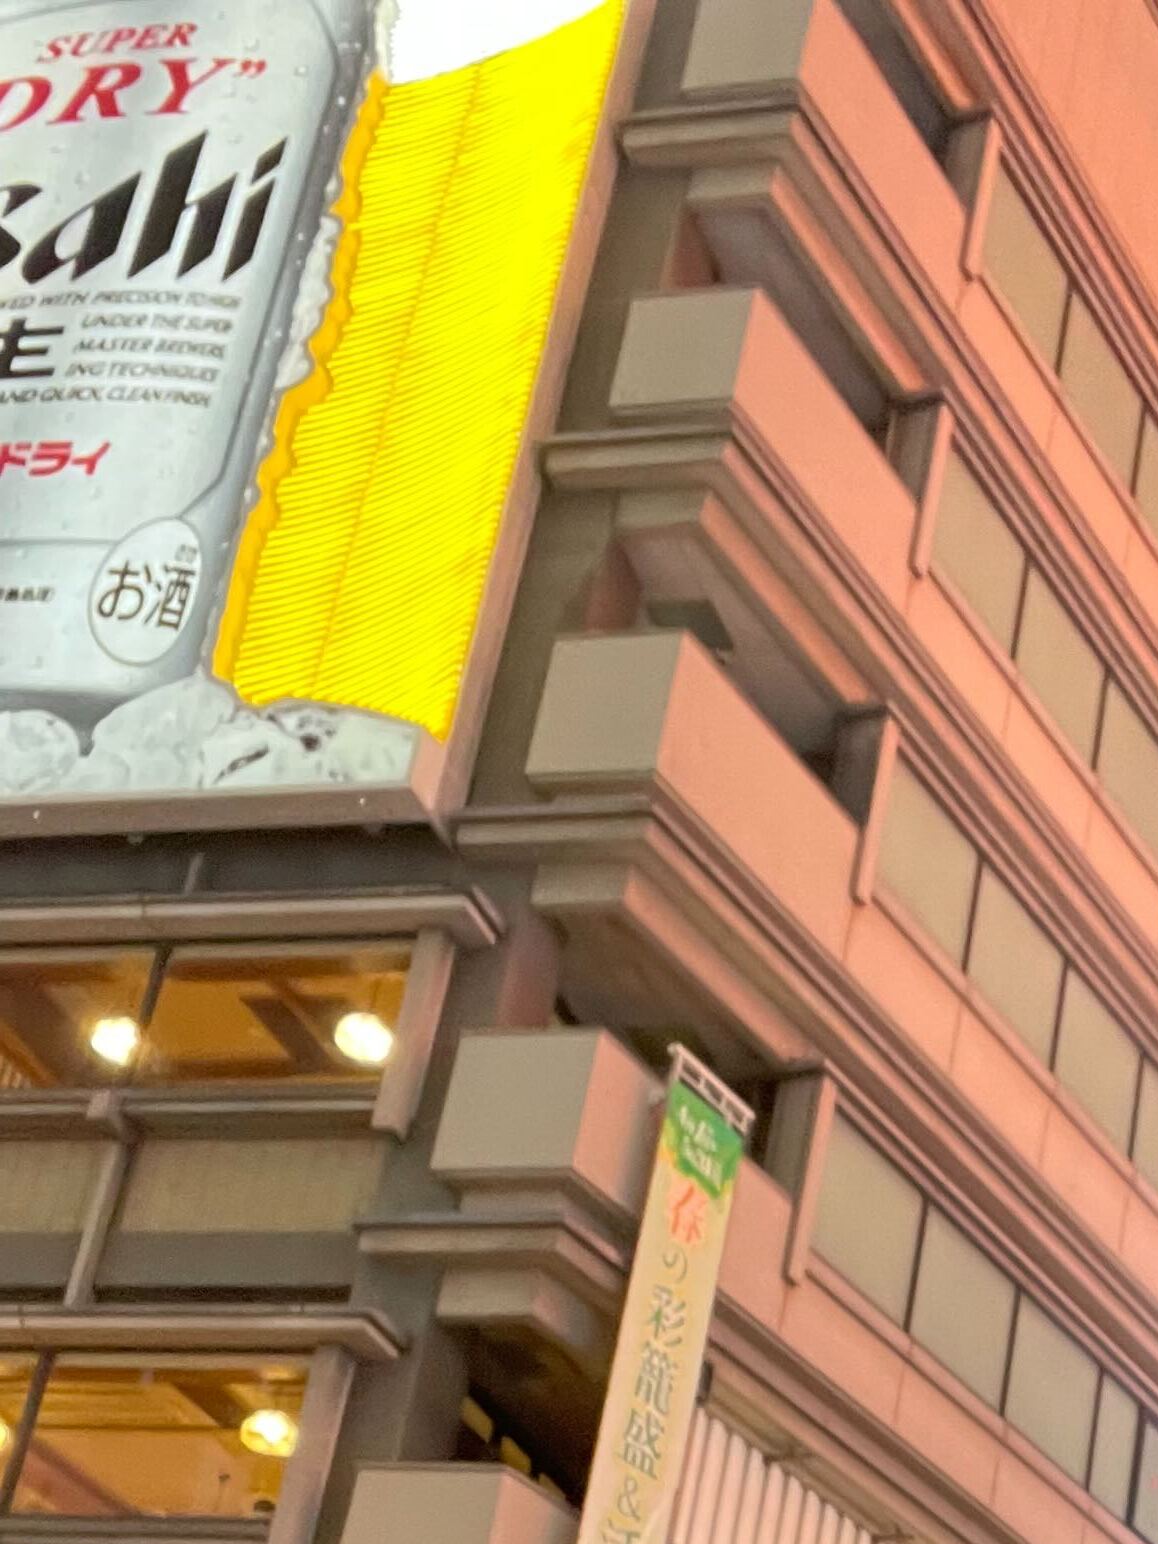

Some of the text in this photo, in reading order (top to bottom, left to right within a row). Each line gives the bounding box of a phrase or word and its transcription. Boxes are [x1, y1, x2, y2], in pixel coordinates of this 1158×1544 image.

[38, 22, 198, 62] SUPER
[80, 313, 149, 329] UNDER
[72, 337, 153, 353] MASTER
[97, 560, 196, 631] お酒
